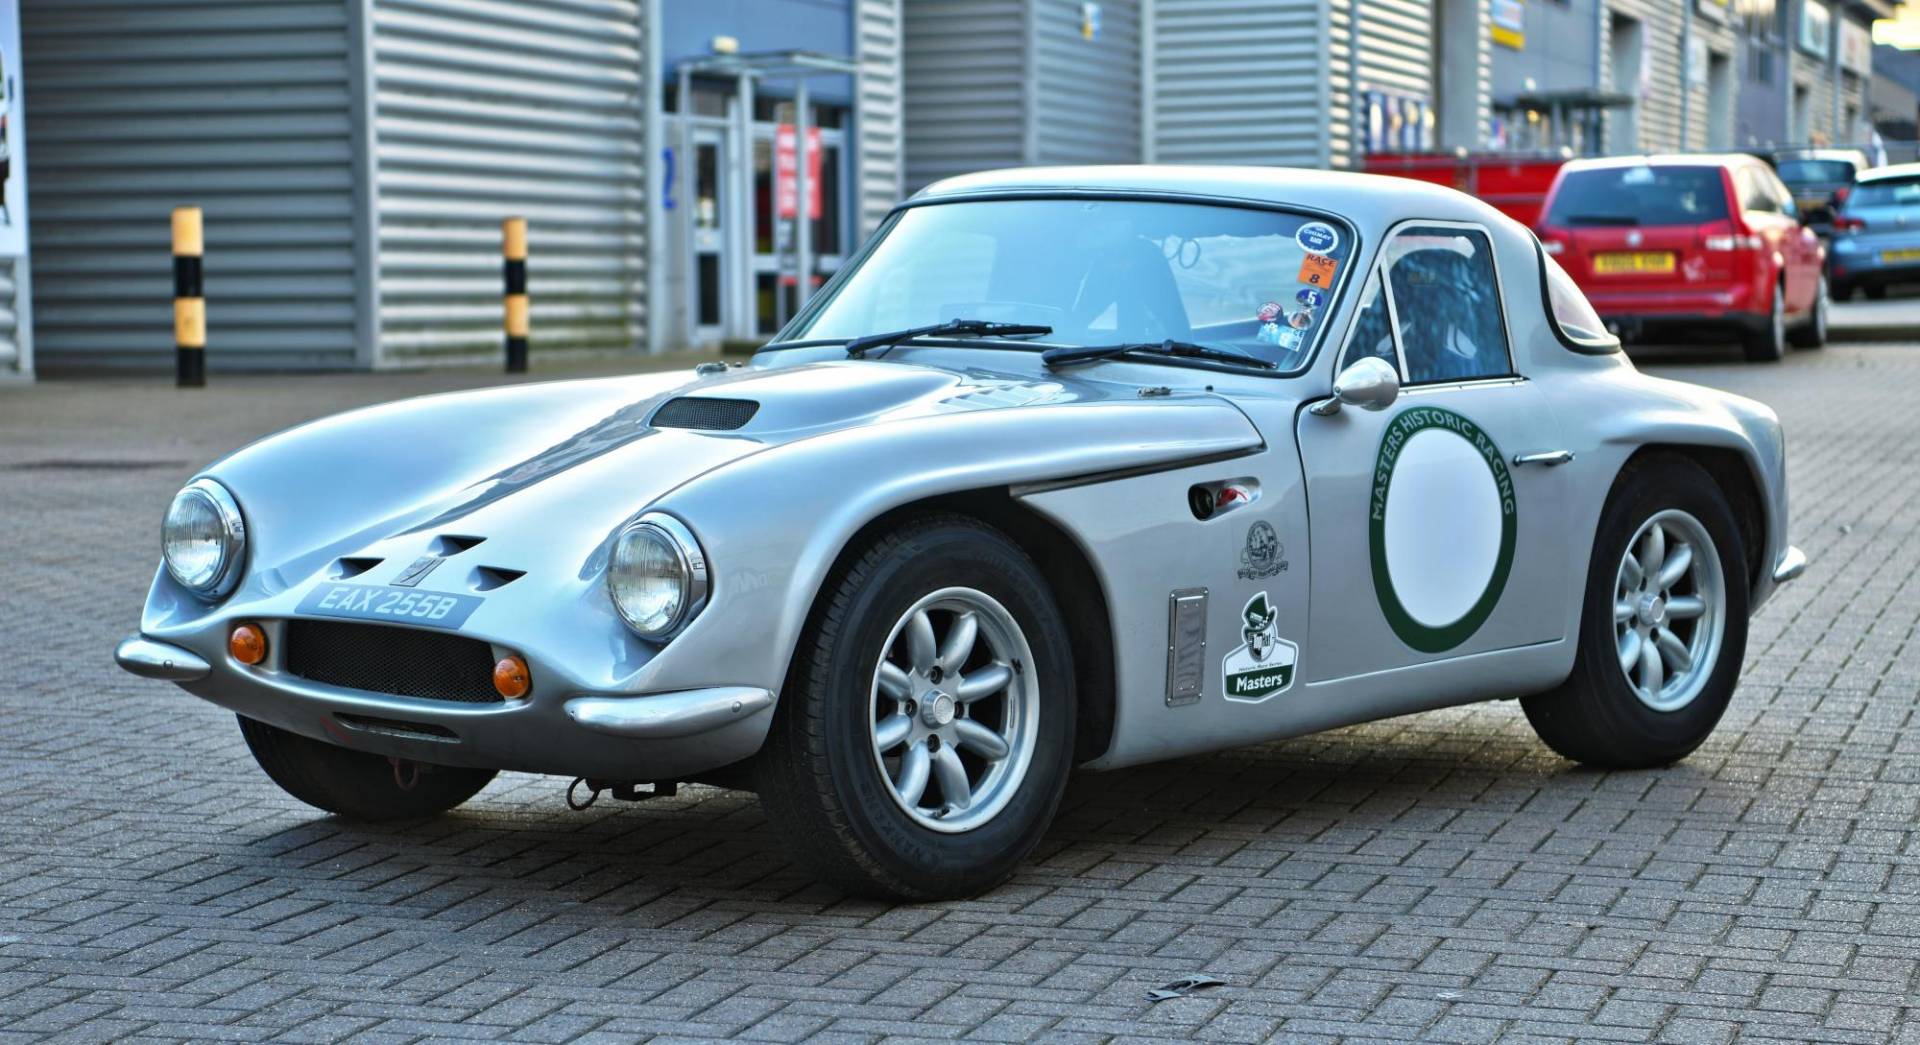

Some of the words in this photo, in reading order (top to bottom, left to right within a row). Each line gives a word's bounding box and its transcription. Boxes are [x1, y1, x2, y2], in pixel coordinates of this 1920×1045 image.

[1306, 254, 1336, 267] RACE
[1309, 274, 1320, 284] 8
[1307, 291, 1318, 305] 5
[1372, 426, 1404, 521] MASTERS
[1400, 410, 1473, 437] HISTORIC
[1475, 432, 1514, 515] RACING
[317, 587, 382, 613] EAX
[374, 592, 458, 619] 255B
[1236, 673, 1283, 692] Masters
